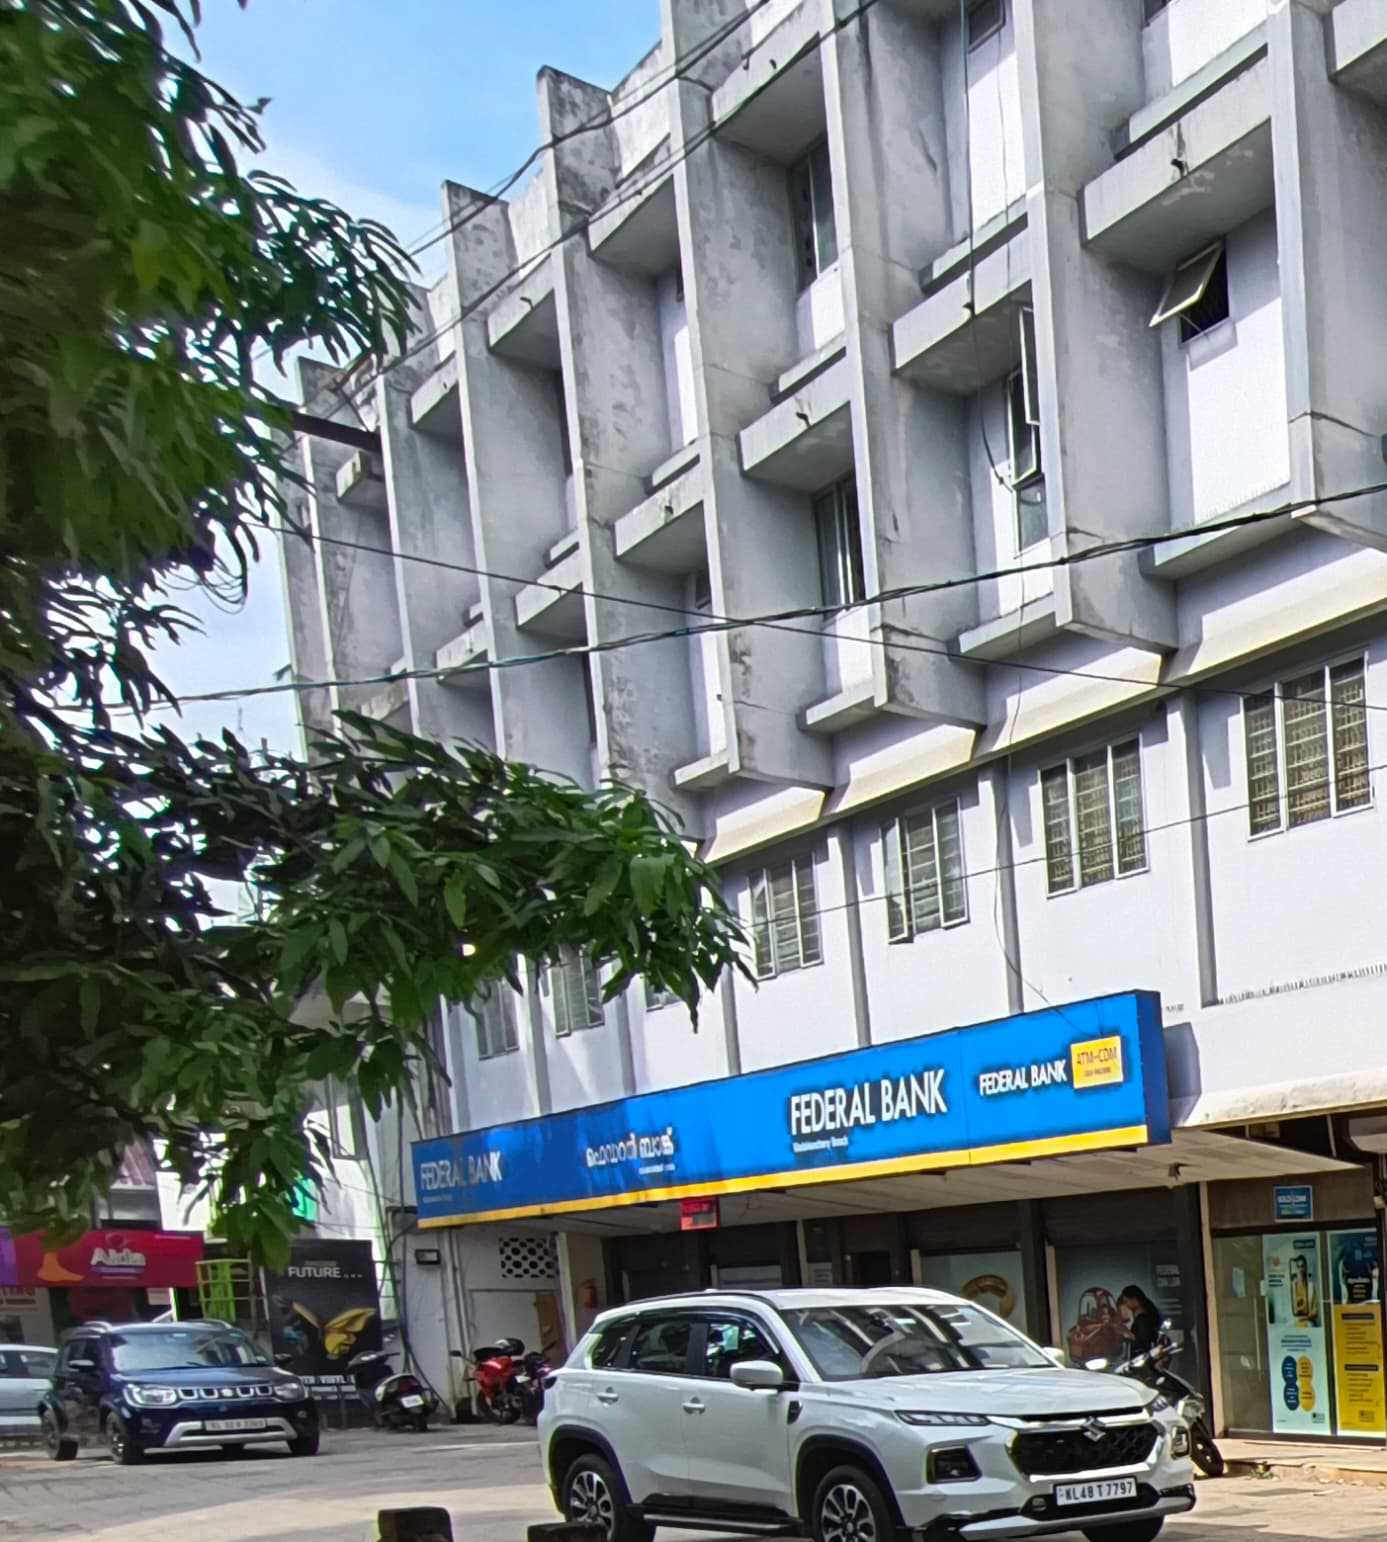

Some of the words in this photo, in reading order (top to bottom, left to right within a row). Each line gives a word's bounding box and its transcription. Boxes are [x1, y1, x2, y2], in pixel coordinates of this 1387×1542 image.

[979, 1066, 1029, 1097] FEDERAL
[1030, 1059, 1068, 1088] BANK
[791, 1082, 877, 1136] FEDERAL
[880, 1068, 948, 1122] BANK
[419, 1158, 465, 1191] FEDERAL
[468, 1151, 504, 1185] BANK
[288, 1266, 342, 1279] FUTURE
